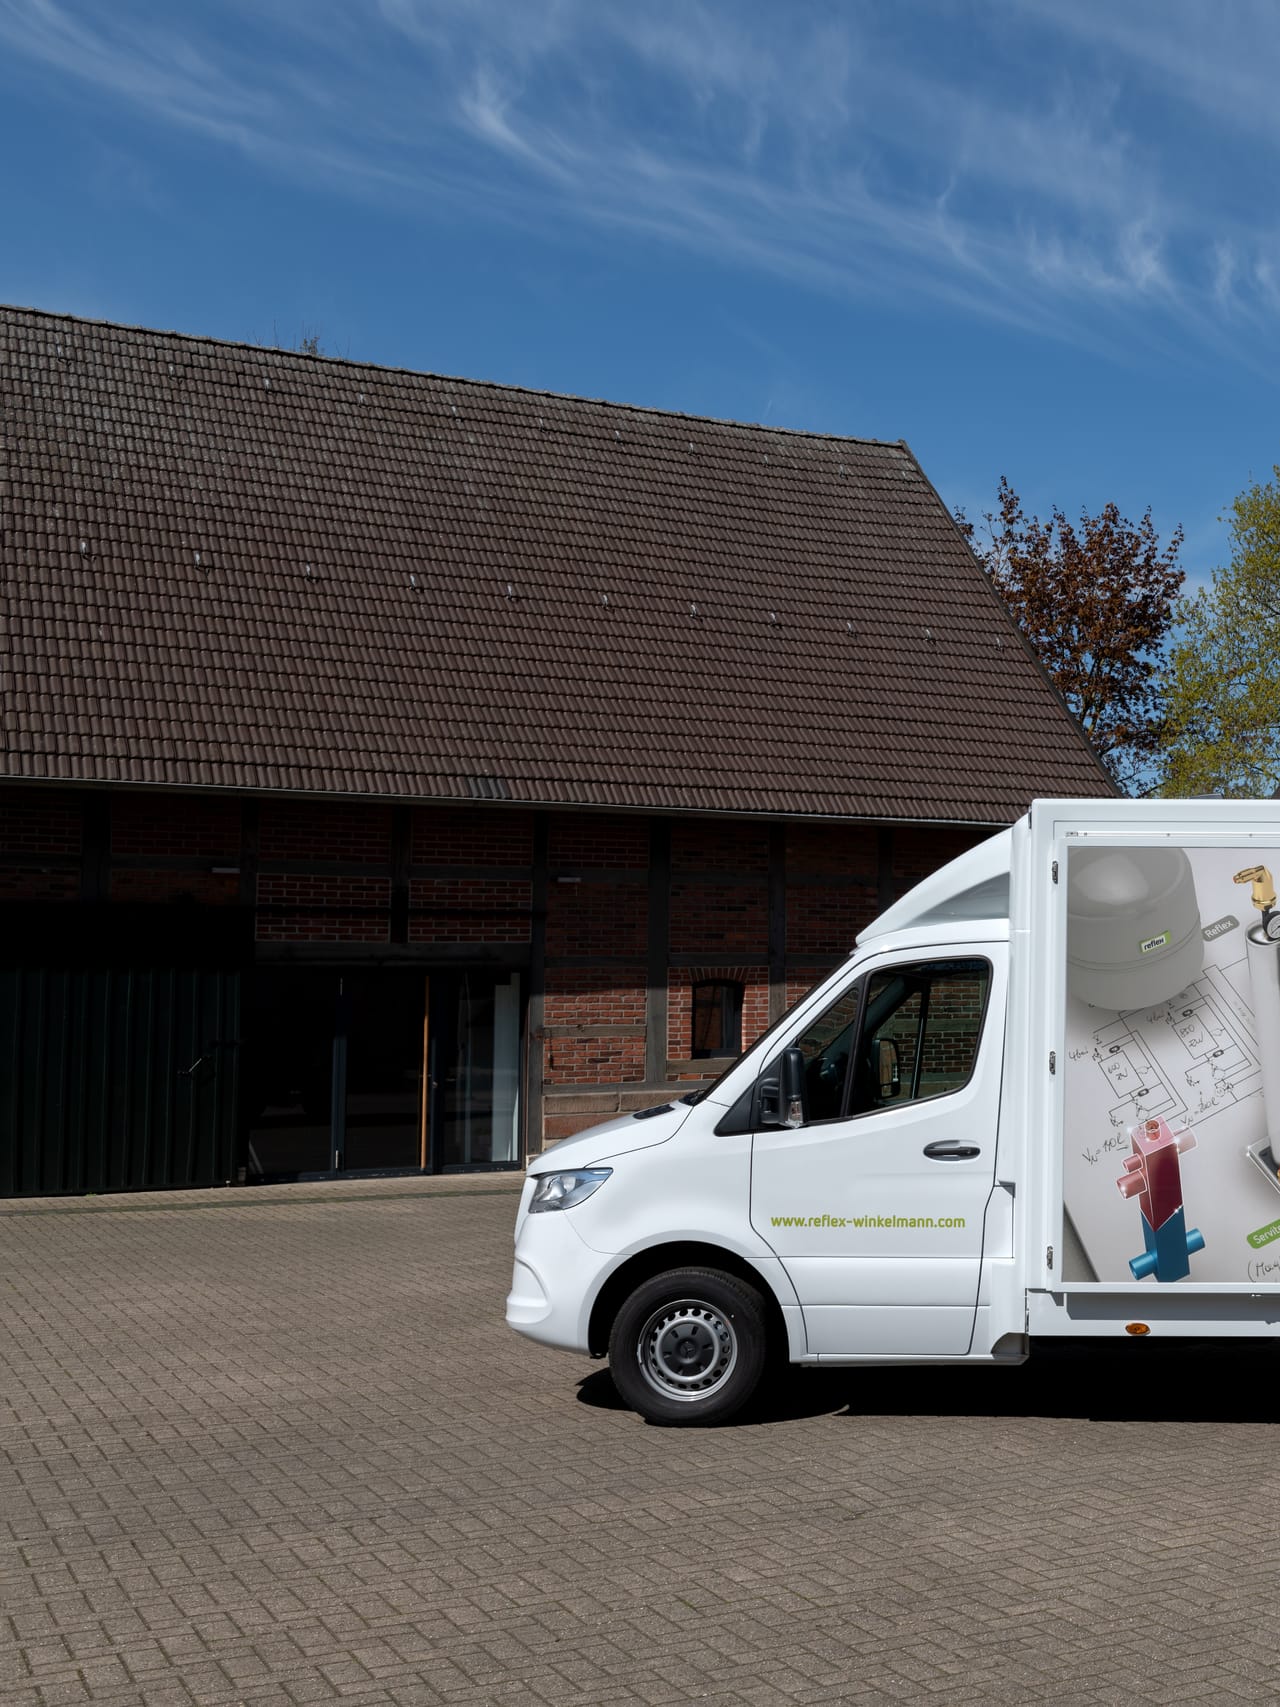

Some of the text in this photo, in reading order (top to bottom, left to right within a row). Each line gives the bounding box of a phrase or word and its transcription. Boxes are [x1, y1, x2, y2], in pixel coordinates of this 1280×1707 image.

[1204, 920, 1234, 938] Reflex
[1143, 937, 1165, 951] reflex
[770, 1214, 966, 1229] www.reflex-winkelmann.com
